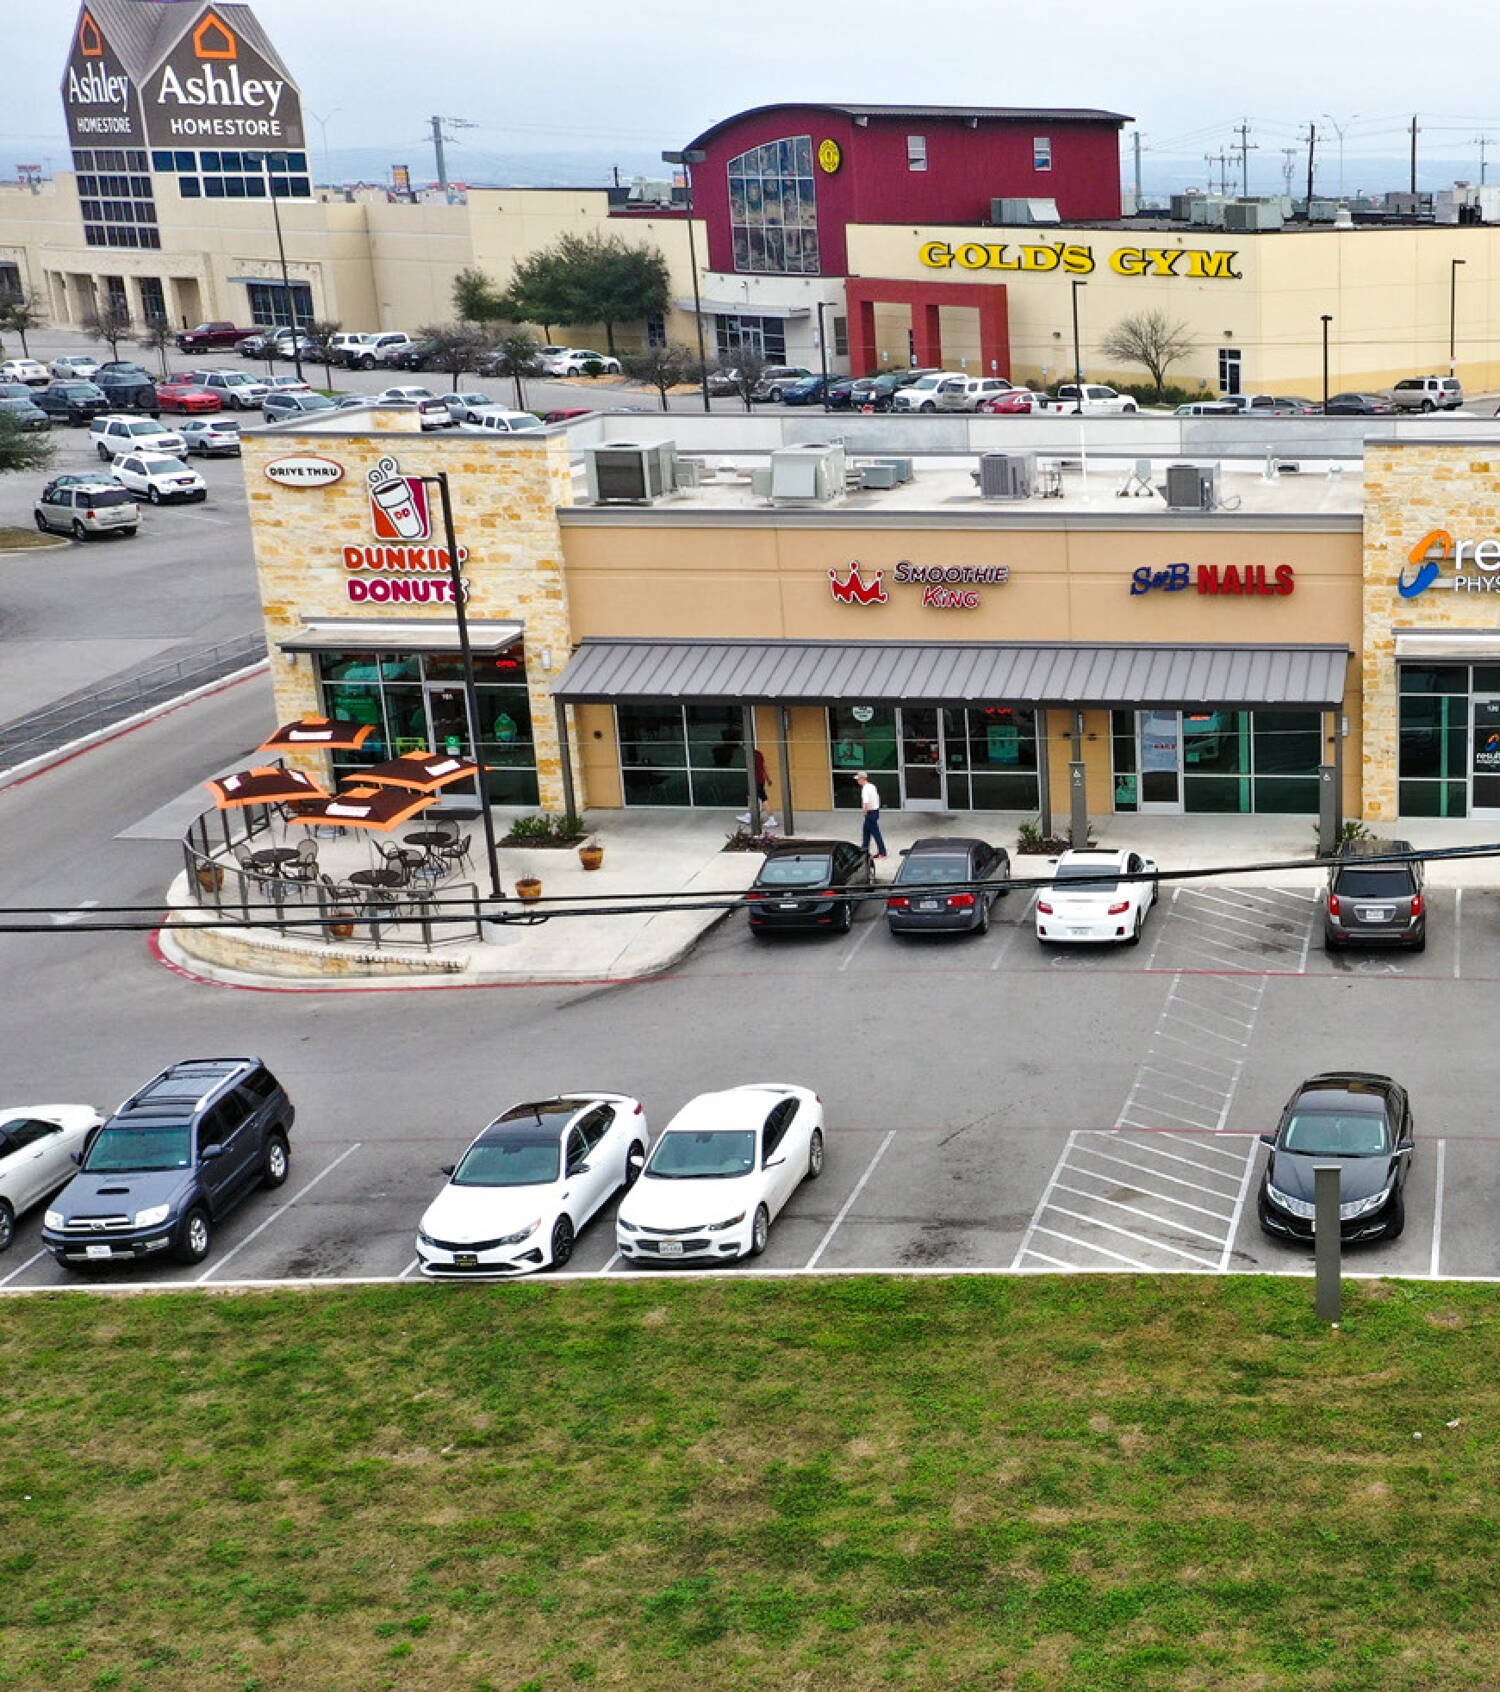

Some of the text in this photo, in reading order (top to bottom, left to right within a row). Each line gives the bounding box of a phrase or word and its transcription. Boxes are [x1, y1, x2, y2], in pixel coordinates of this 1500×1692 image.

[69, 62, 129, 113] Ashley
[157, 63, 284, 117] Ashley
[77, 117, 131, 134] HOMESTORE
[171, 118, 282, 137] HOMESTORE
[919, 241, 1239, 278] GOLD'S GYM
[269, 467, 338, 477] DRIVE THRU
[394, 507, 410, 520] DD
[343, 546, 467, 571] DUNKIN'
[893, 560, 1009, 584] SMOOTHIE
[1196, 564, 1295, 596] NAILS
